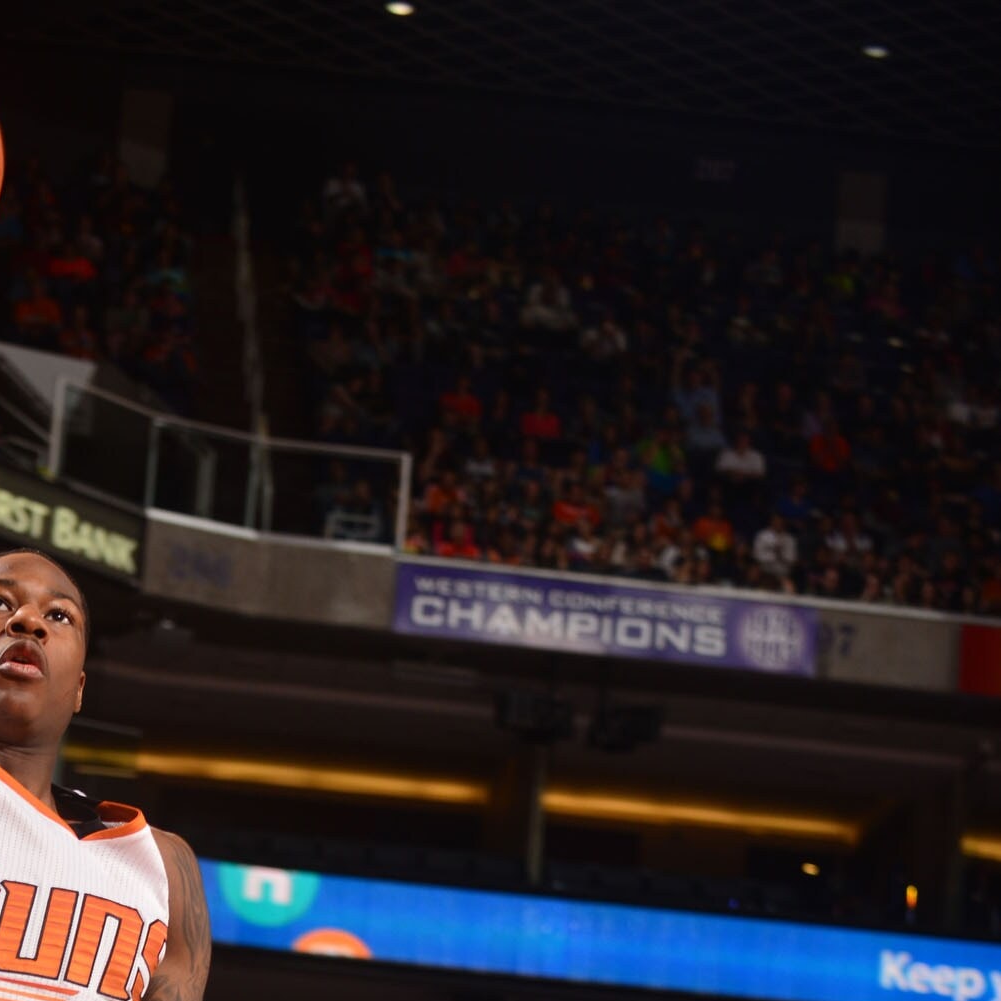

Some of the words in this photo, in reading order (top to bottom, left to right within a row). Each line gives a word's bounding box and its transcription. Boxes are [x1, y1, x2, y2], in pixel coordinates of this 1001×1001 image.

[52, 506, 139, 575] BANK
[410, 595, 727, 657] CHAMPIONS
[414, 575, 543, 605] WESTERN
[548, 588, 727, 622] CONFERENCE
